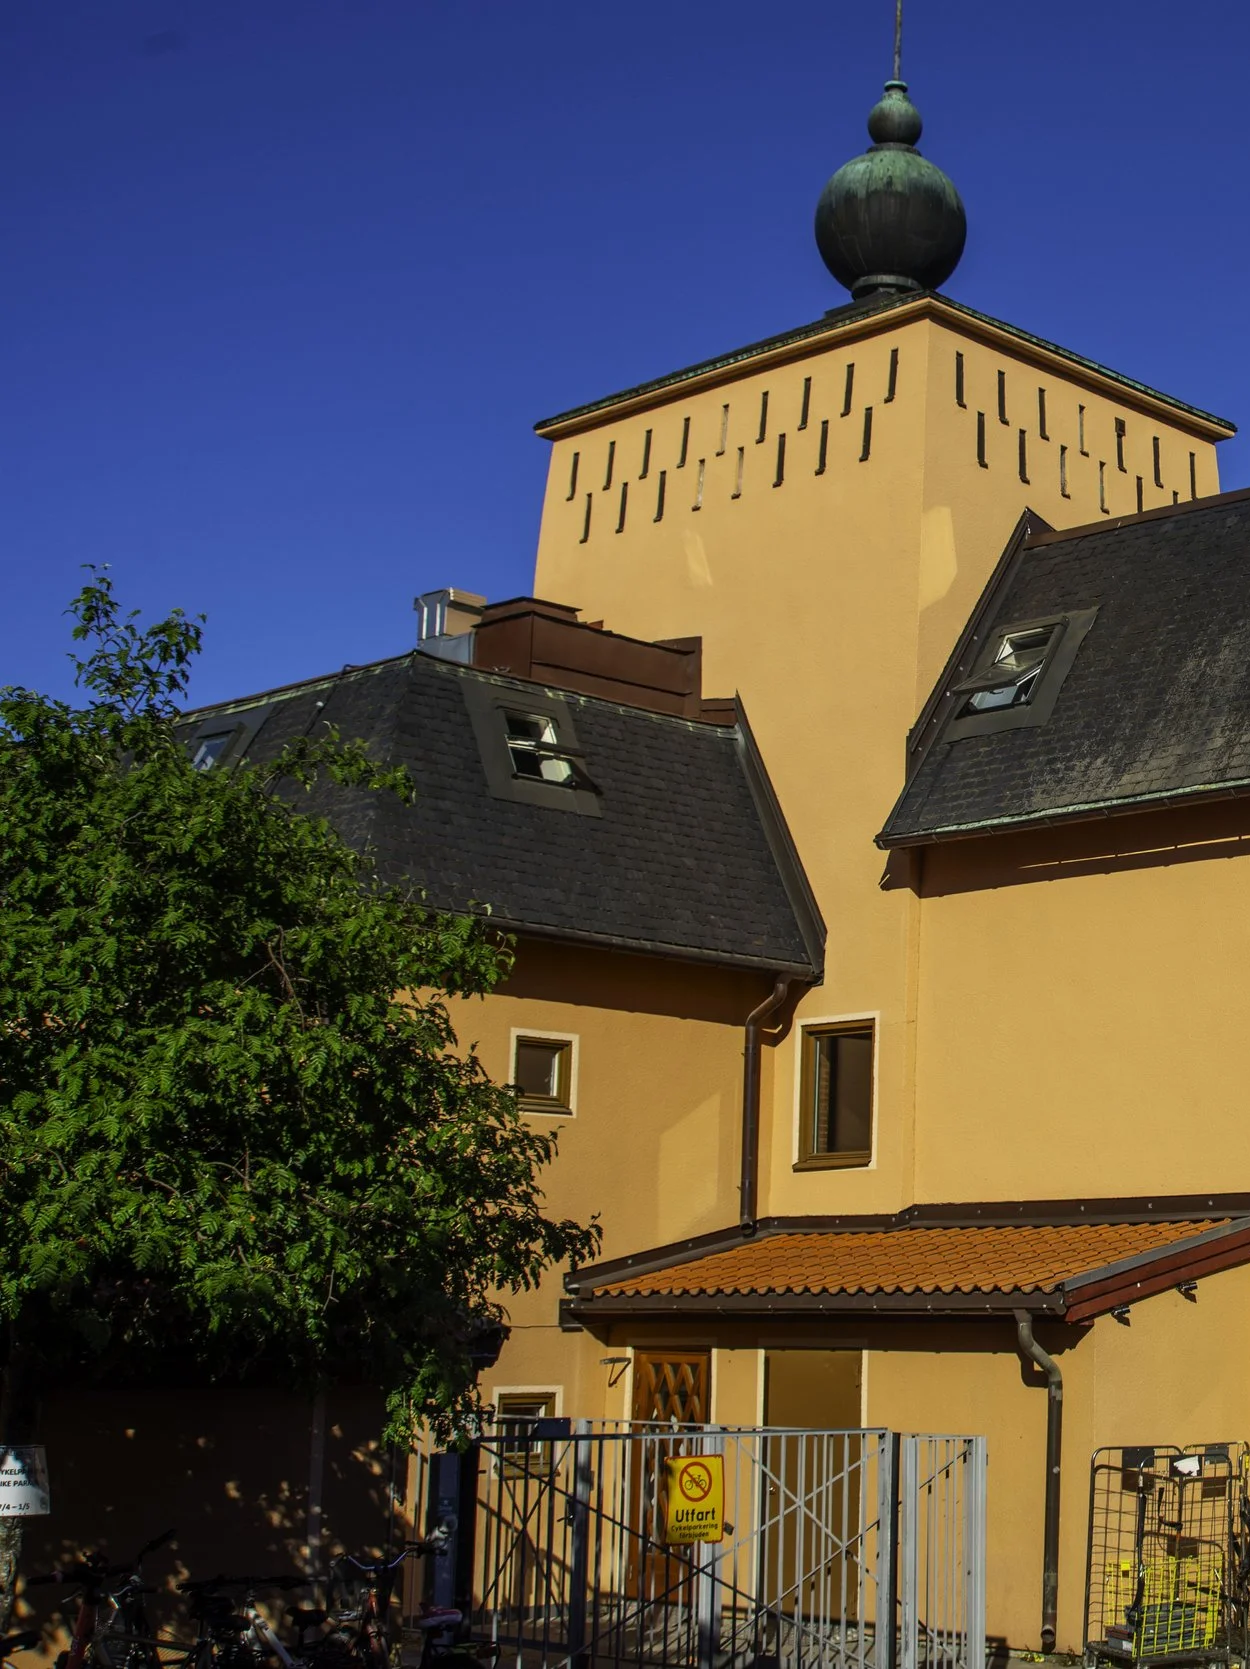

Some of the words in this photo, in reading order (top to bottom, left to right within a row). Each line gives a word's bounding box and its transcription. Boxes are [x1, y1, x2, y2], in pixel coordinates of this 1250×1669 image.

[675, 1507, 715, 1522] Utfart
[671, 1523, 718, 1532] Cykelparkering
[679, 1531, 709, 1539] förbjuden
